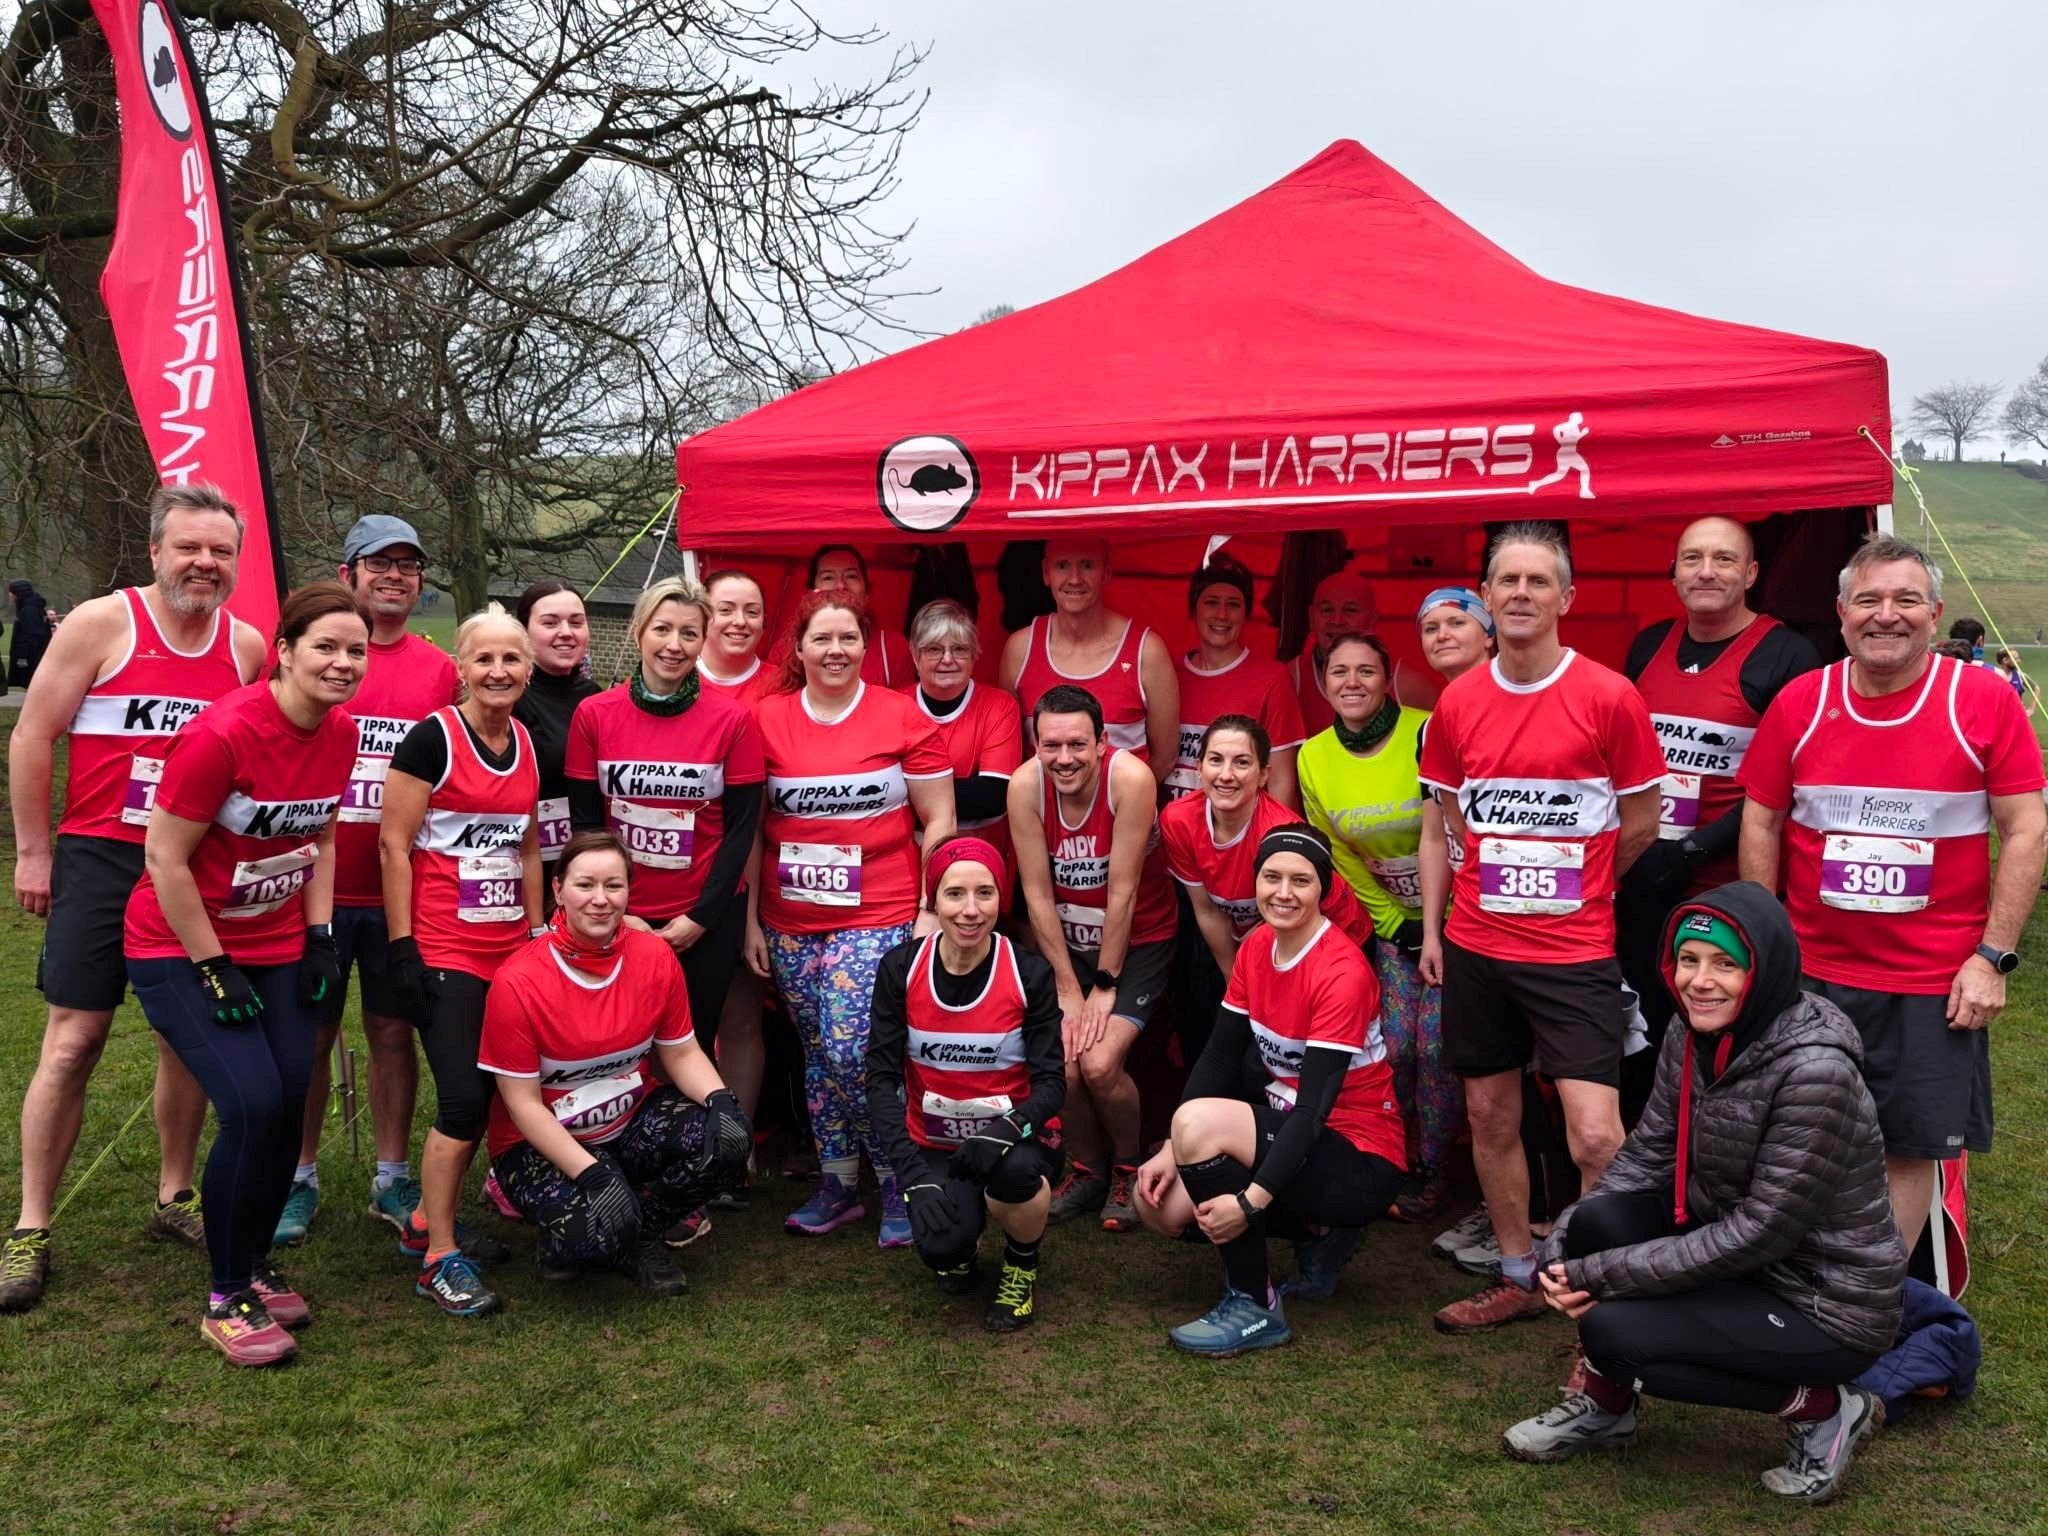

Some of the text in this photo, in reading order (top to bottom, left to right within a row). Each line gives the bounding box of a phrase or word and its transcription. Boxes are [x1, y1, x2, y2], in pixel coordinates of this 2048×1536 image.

[1009, 424, 1536, 500] KIPPAX HARRIERS
[123, 698, 208, 731] KIPPA
[607, 764, 678, 796] KIPPAX
[629, 778, 705, 798] HARRIERS
[774, 784, 854, 814] KIPPAX
[796, 797, 887, 815] HARRIERS
[1464, 789, 1547, 823] KIPPAX
[1862, 796, 1913, 814] KIPPAX
[243, 803, 324, 838] KIPPAX
[1486, 805, 1580, 827] HARRIERS
[1858, 811, 1927, 832] HARRIERS
[451, 823, 522, 849] KIPPAX
[619, 823, 680, 855] 1033
[1519, 855, 1538, 864] Paul
[1867, 852, 1882, 862] Jay
[244, 869, 304, 905] 1038
[788, 864, 849, 891] 1036
[1499, 867, 1557, 898] 385
[1842, 863, 1906, 895] 390
[479, 880, 516, 906] 384
[920, 1042, 977, 1061] KIPPAX
[939, 1051, 998, 1064] HARRIERS
[571, 1093, 634, 1129] 1040
